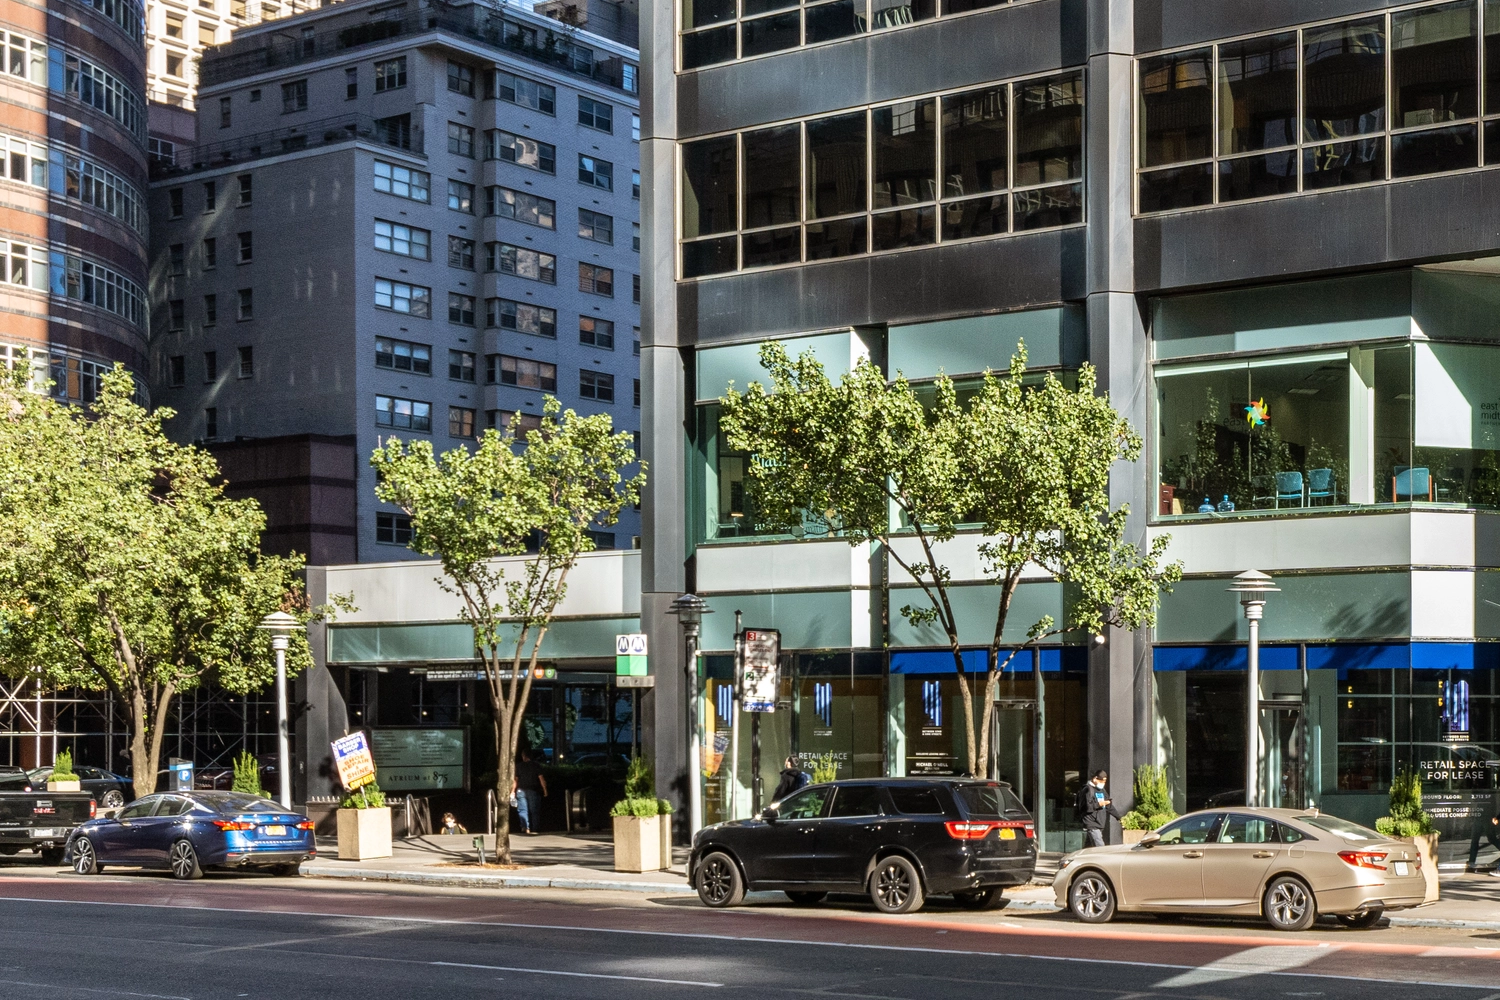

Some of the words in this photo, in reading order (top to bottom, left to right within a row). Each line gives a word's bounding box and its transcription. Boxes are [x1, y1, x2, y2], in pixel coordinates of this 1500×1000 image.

[1481, 402, 1498, 410] east
[342, 758, 369, 772] REPAIR
[344, 755, 364, 766] SHOE
[1420, 760, 1456, 769] RETAIL
[1458, 760, 1491, 769] SPACE
[347, 766, 369, 779] SHINE
[432, 771, 449, 784] 875
[1427, 771, 1449, 780] FOR
[1452, 771, 1484, 780] LEASE
